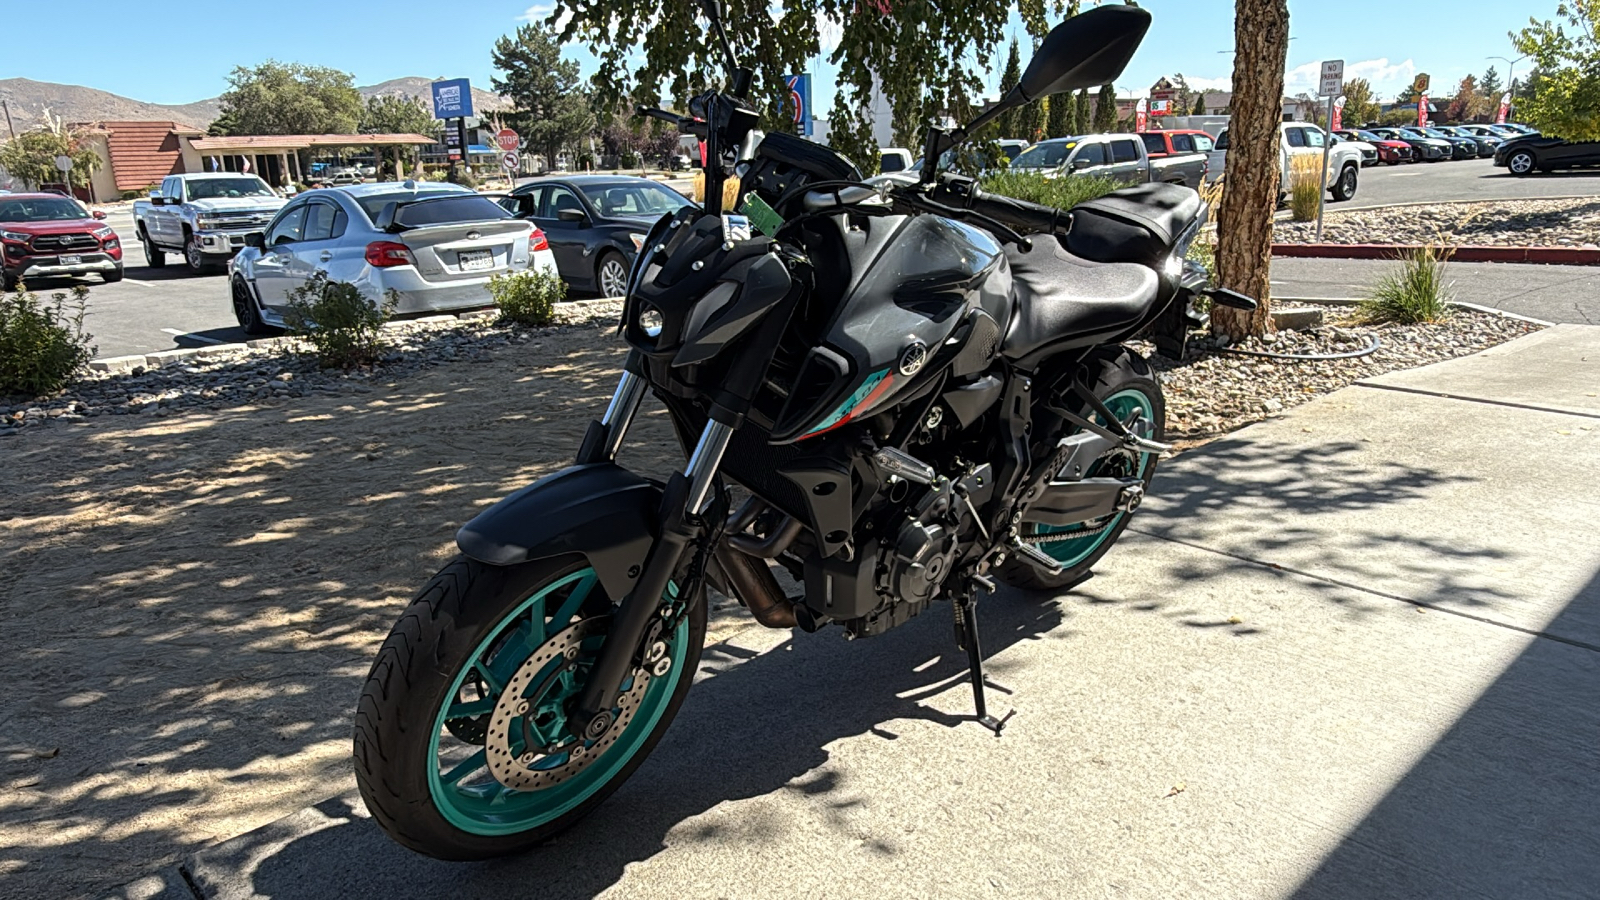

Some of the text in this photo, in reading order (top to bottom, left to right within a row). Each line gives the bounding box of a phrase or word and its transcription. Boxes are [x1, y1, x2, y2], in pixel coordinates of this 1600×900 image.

[1327, 64, 1337, 72] NO
[1323, 72, 1342, 80] PARKING
[498, 135, 517, 145] STOP
